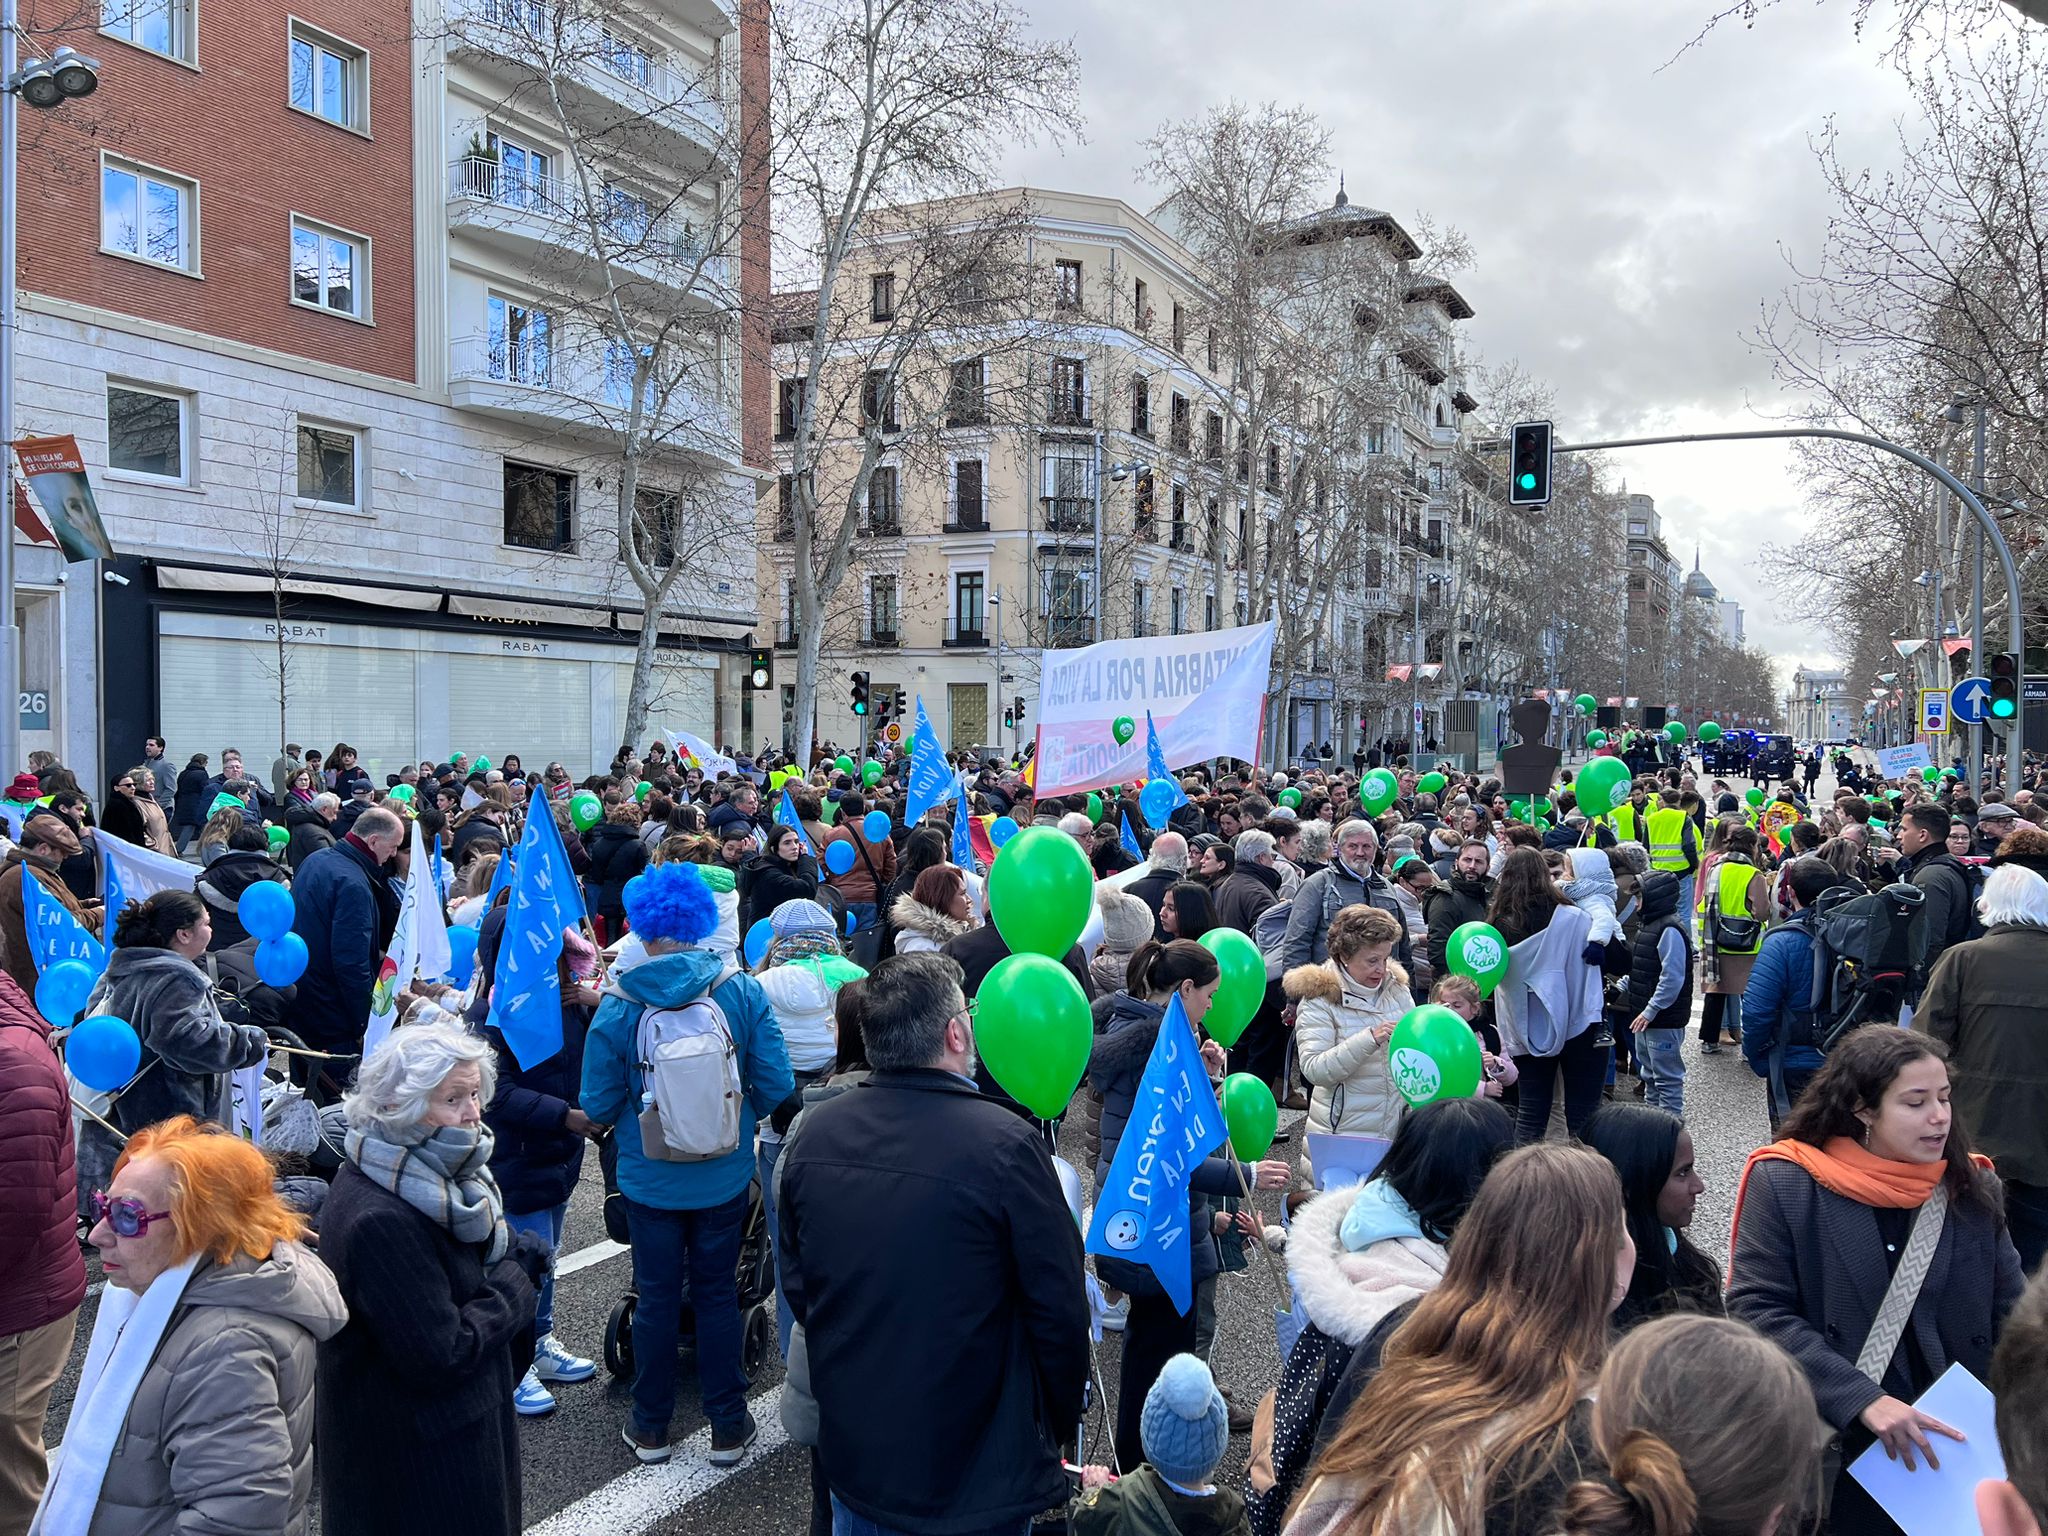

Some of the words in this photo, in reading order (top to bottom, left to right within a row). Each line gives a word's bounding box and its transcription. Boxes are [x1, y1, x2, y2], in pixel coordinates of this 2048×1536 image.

[265, 624, 327, 638] RABAT
[502, 640, 549, 653] RABAT
[20, 692, 47, 714] 26
[37, 903, 62, 926] EN
[70, 941, 91, 959] LA
[1472, 936, 1494, 954] Sí
[1397, 1050, 1424, 1079] Sí
